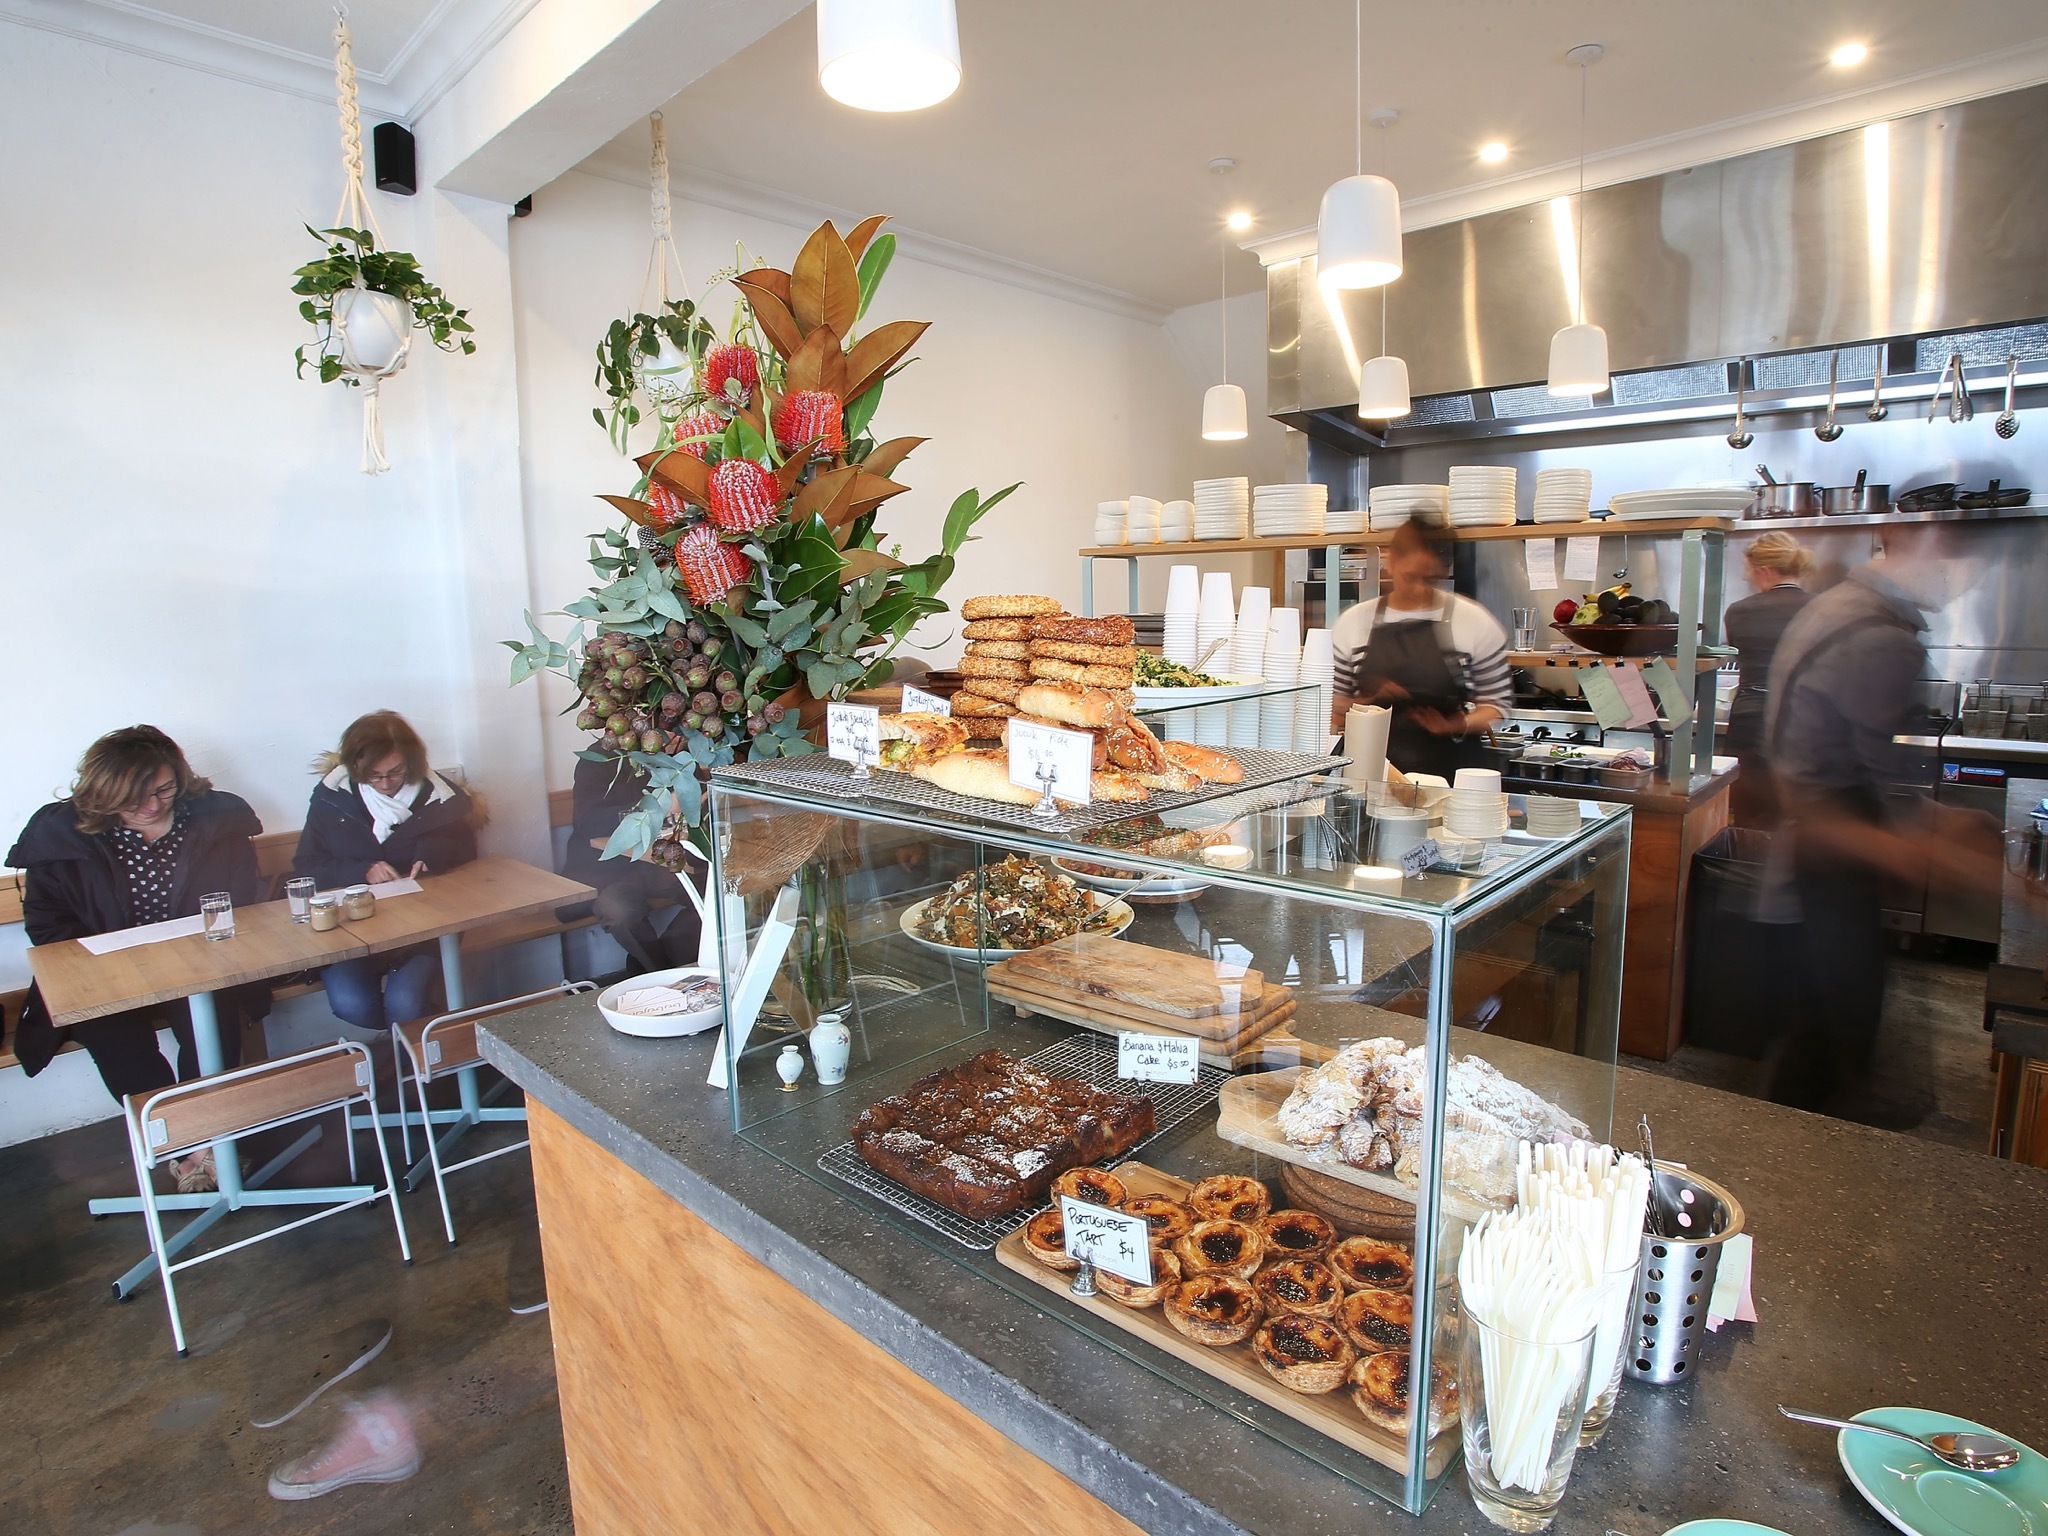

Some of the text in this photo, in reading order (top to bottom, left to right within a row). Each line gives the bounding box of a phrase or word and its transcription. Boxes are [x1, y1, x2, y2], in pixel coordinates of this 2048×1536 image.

[1050, 733, 1071, 748] Pide
[1122, 1038, 1155, 1051] Banana
[1163, 1040, 1189, 1054] Halva
[1137, 1054, 1160, 1066] Cake
[1068, 1207, 1133, 1233] PORTUGUESE
[1075, 1229, 1106, 1247] TART
[1118, 1238, 1135, 1263] $4
